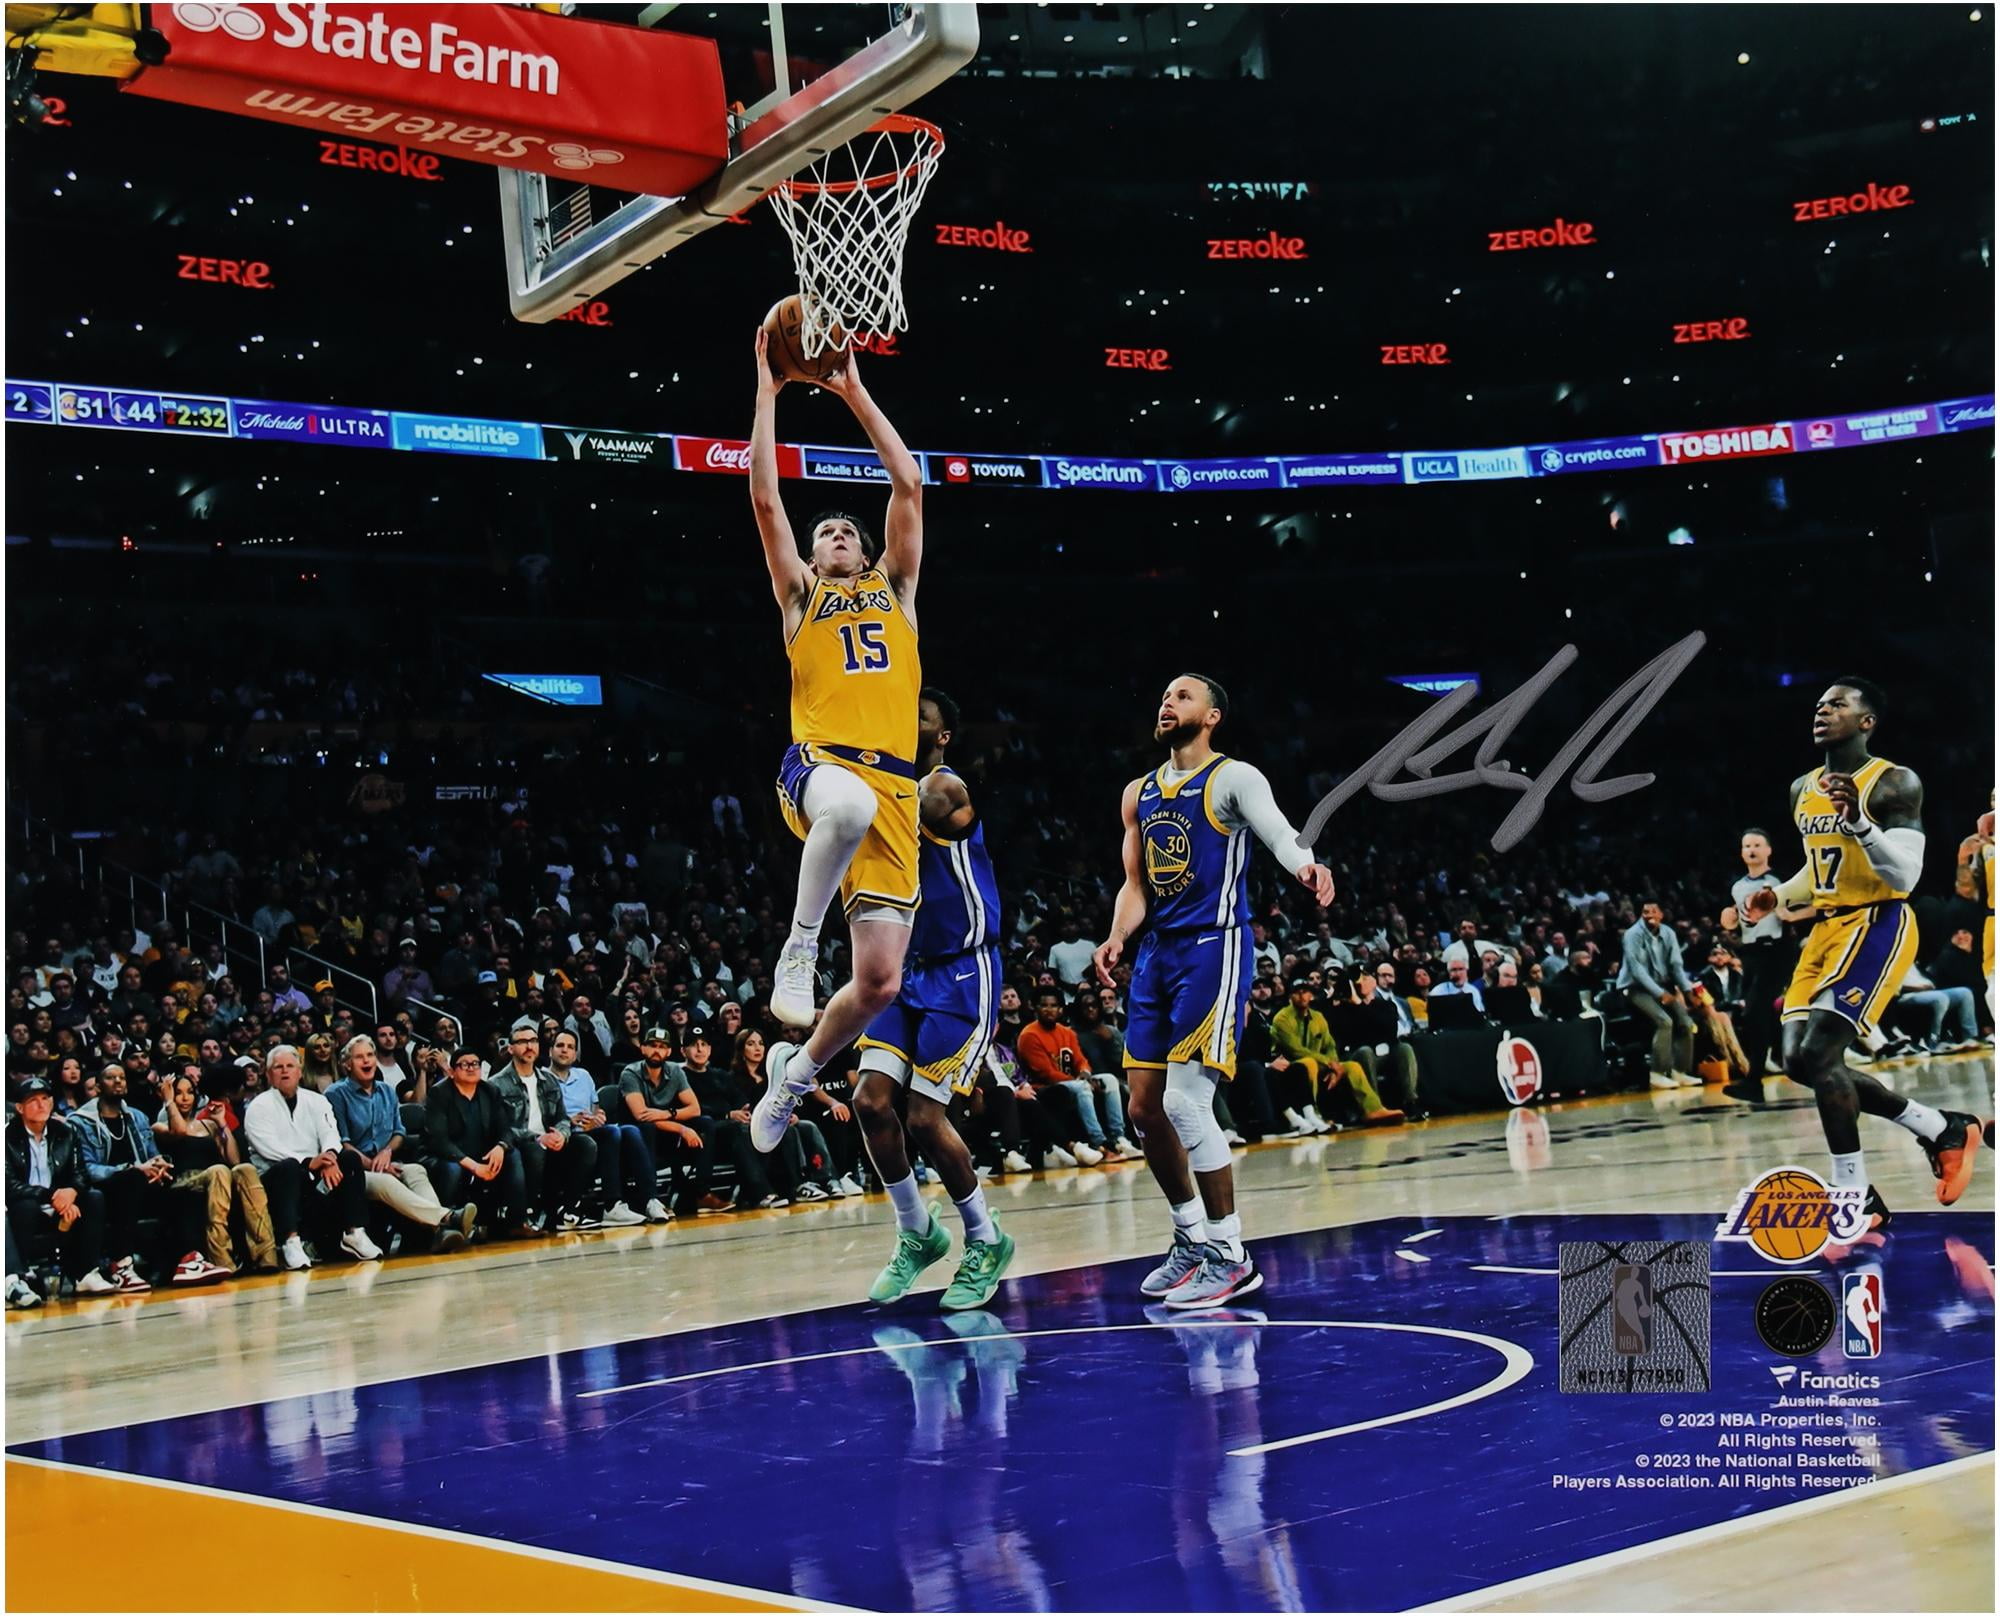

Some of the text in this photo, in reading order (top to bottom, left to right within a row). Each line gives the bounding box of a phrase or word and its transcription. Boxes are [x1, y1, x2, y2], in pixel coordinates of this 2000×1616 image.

[77, 397, 104, 420] 51
[127, 401, 157, 423] 44
[178, 405, 227, 429] 2:32
[239, 411, 384, 437] Michelob ULTRA
[414, 423, 520, 446] mobilitie
[1665, 428, 1790, 459] TOSHIBA
[1417, 457, 1518, 475] UCLA Health
[1565, 446, 1647, 465] crypto.com
[814, 463, 851, 477] Achelle
[853, 465, 862, 476] &
[971, 463, 1025, 478] TOYOTA
[1056, 461, 1144, 486] Spectrum
[1193, 468, 1269, 483] crypto.com
[1289, 466, 1347, 477] AMERICAN
[838, 620, 892, 675] 15
[519, 678, 584, 695] obilitie
[1172, 811, 1193, 831] STATE
[1165, 836, 1185, 854] 30
[1809, 845, 1844, 892] 17
